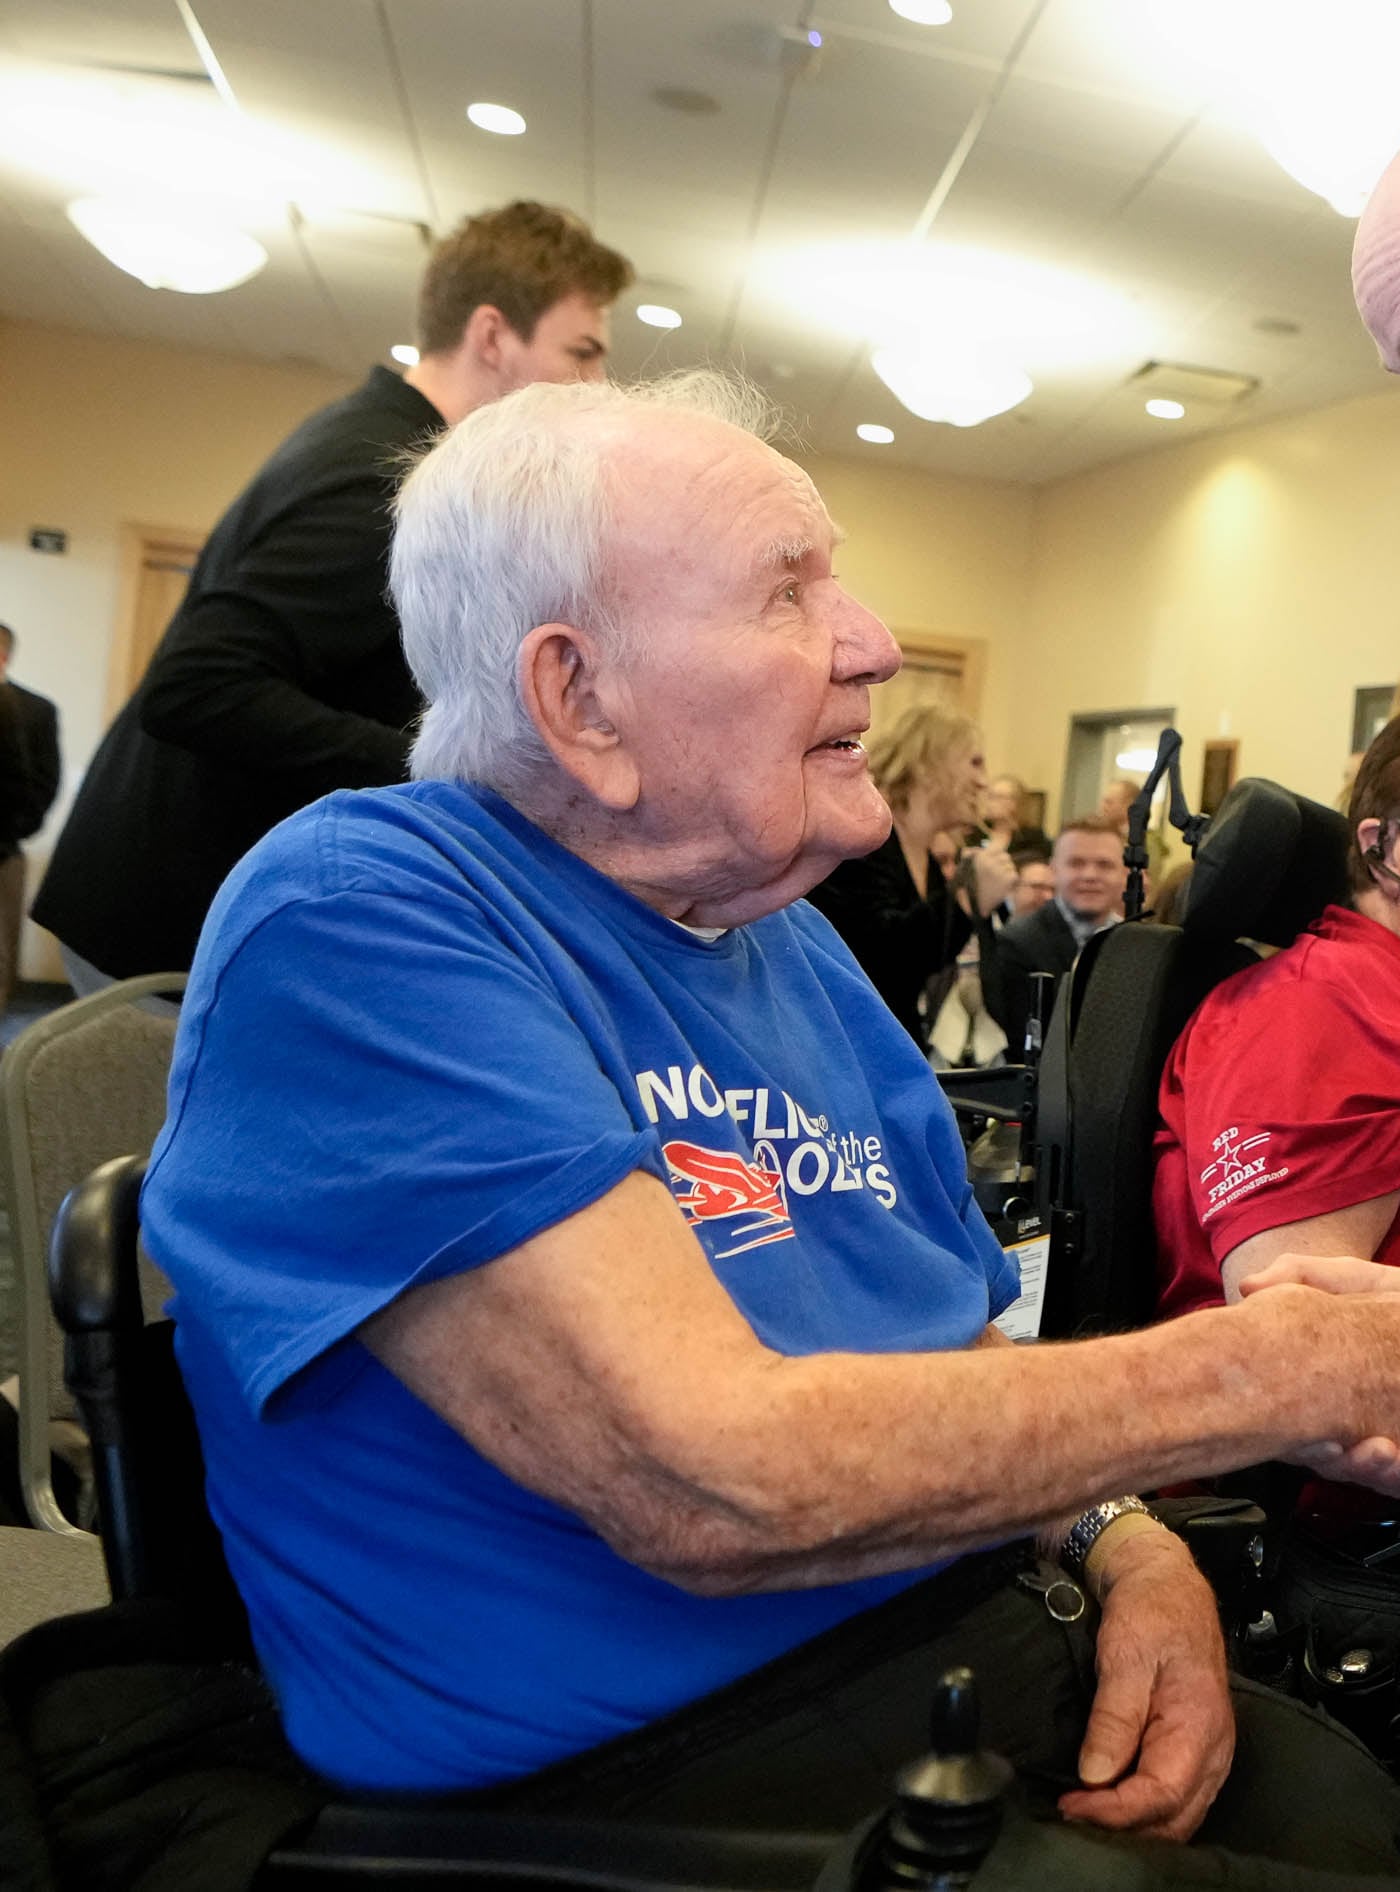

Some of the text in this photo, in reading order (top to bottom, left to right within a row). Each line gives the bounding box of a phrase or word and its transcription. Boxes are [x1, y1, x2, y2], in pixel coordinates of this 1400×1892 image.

[841, 1131, 882, 1165] the
[1212, 1126, 1239, 1152] RED
[1208, 1157, 1266, 1203] FRIDAY
